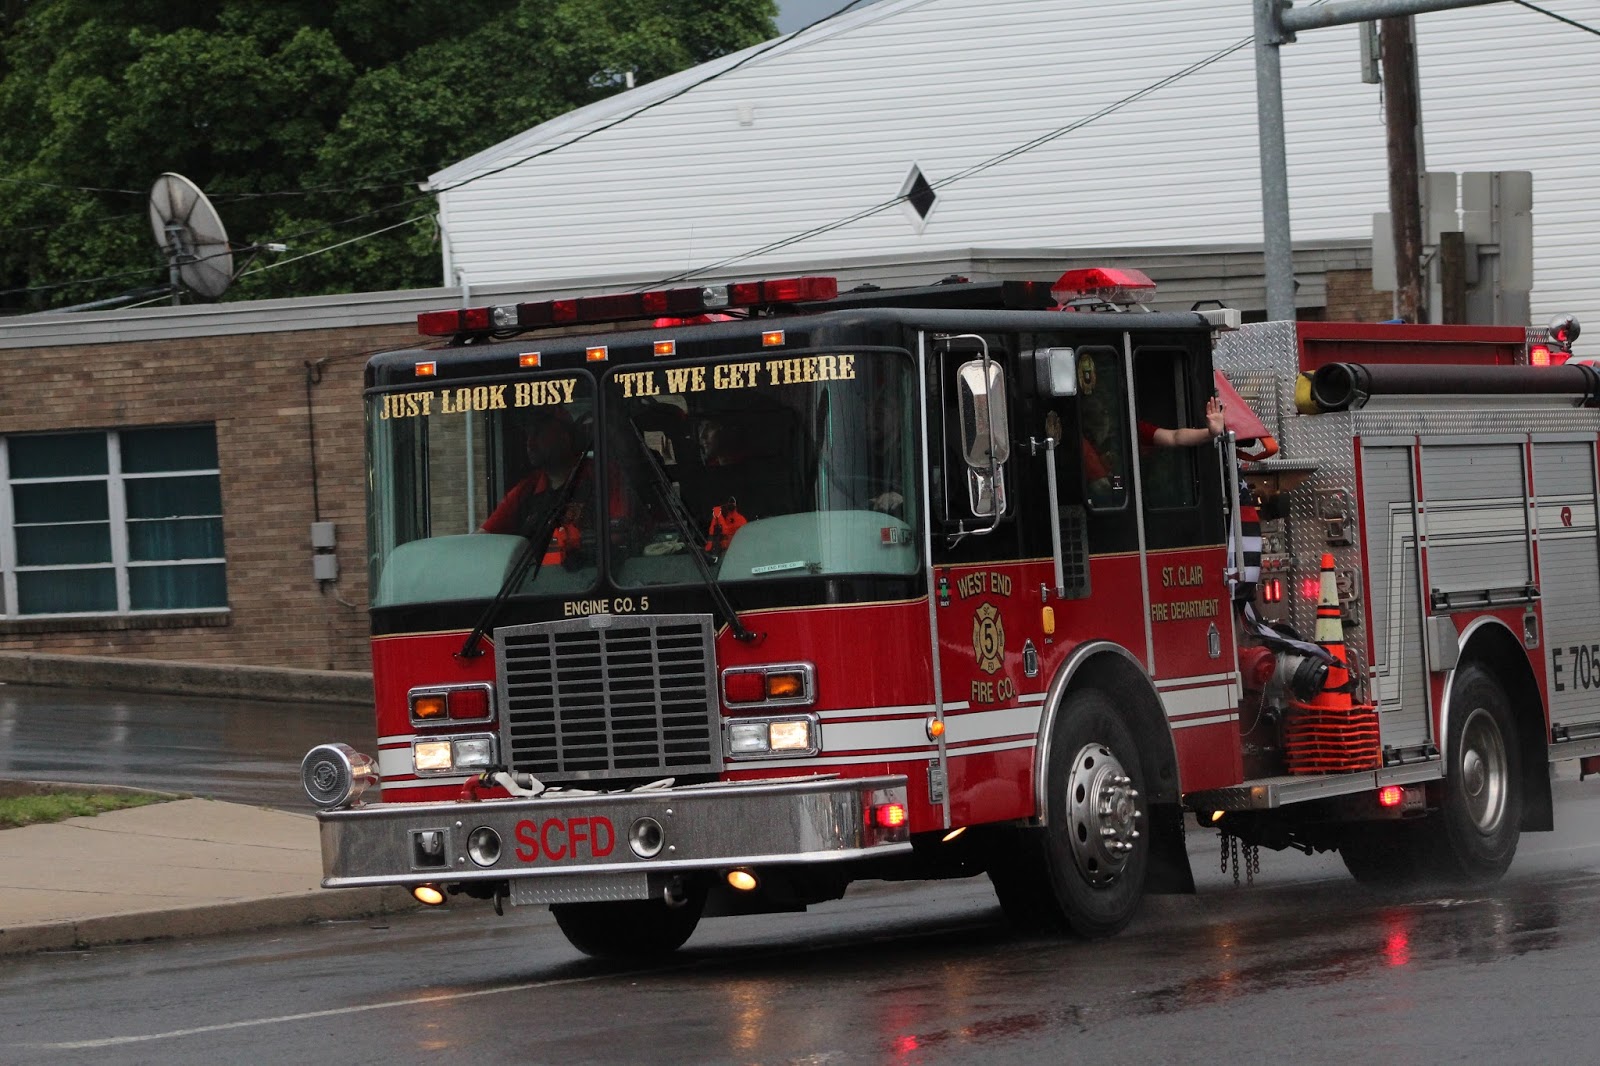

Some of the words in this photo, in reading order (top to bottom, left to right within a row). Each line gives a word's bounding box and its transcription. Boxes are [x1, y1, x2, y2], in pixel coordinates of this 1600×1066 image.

[665, 366, 706, 393] WE
[713, 362, 761, 390] GET
[766, 354, 856, 386] THERE
[380, 391, 434, 420] JUST
[441, 384, 508, 414] LOOK
[514, 378, 577, 408] BUSY
[957, 571, 987, 599] WEST
[990, 571, 1012, 596] END
[1162, 566, 1177, 587] ST.
[1178, 565, 1204, 586] CLAIR
[564, 599, 610, 616] ENGINE
[614, 597, 636, 613] CO.
[640, 596, 649, 611] 5
[1151, 603, 1169, 621] FIRE
[1170, 598, 1219, 620] DEPARTMENT
[984, 623, 994, 655] 5
[987, 662, 995, 671] FD
[1552, 647, 1565, 692] E
[1569, 644, 1600, 690] 705
[971, 680, 994, 703] FIRE
[997, 676, 1015, 701] CO.
[514, 815, 616, 863] SCFD
